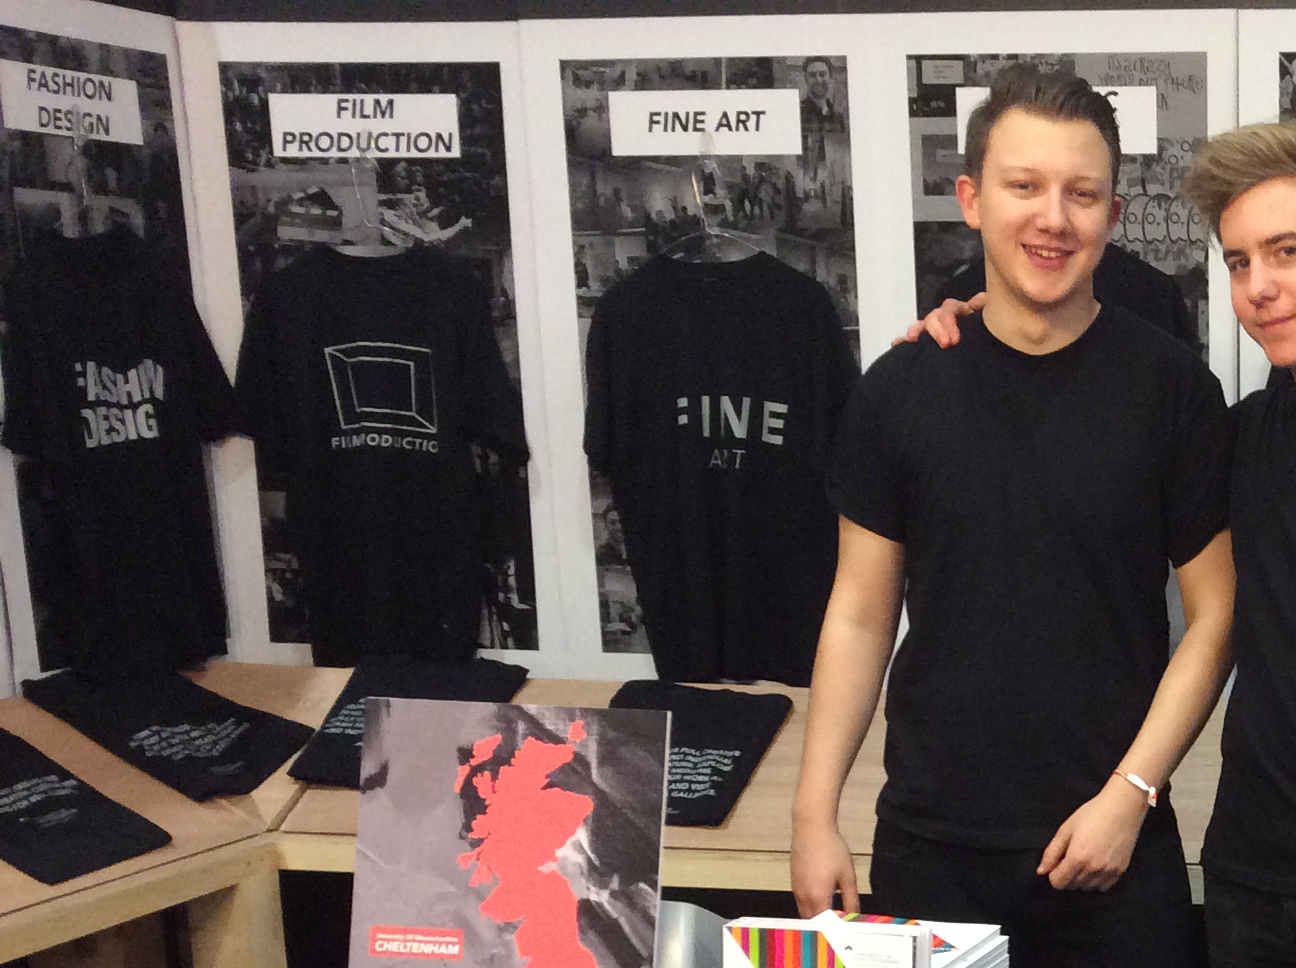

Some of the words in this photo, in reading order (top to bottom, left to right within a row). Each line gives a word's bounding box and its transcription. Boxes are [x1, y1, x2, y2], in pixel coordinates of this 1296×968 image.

[27, 68, 112, 102] FASHION
[336, 98, 394, 119] FILM
[38, 106, 110, 136] DESIGN
[648, 111, 706, 133] FINE
[714, 110, 766, 132] ART
[282, 131, 453, 152] PRODUCTION
[375, 941, 459, 955] CHELTENHAM
